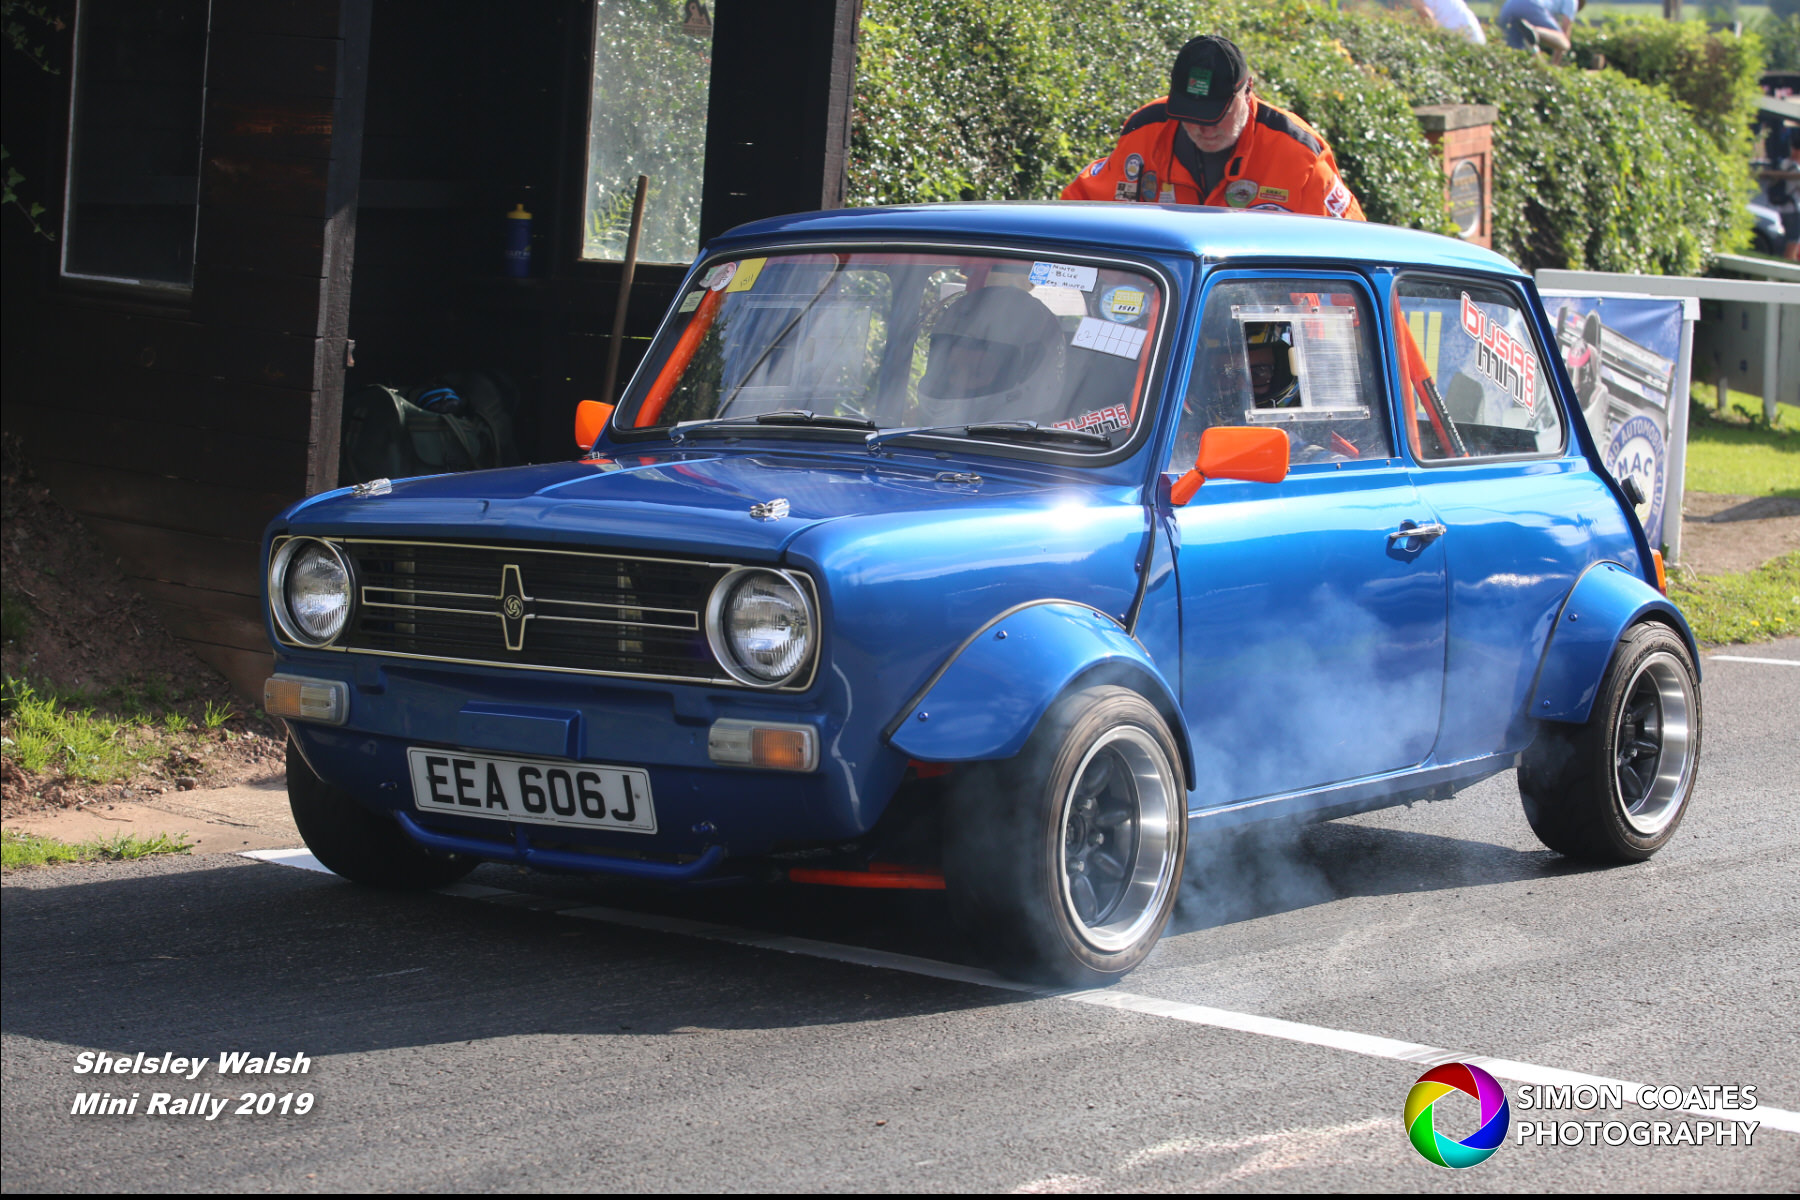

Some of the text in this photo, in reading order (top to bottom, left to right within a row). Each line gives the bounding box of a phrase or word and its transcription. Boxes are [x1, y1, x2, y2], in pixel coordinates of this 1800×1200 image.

[1618, 452, 1653, 478] MAC
[425, 755, 636, 822] EEA 606J
